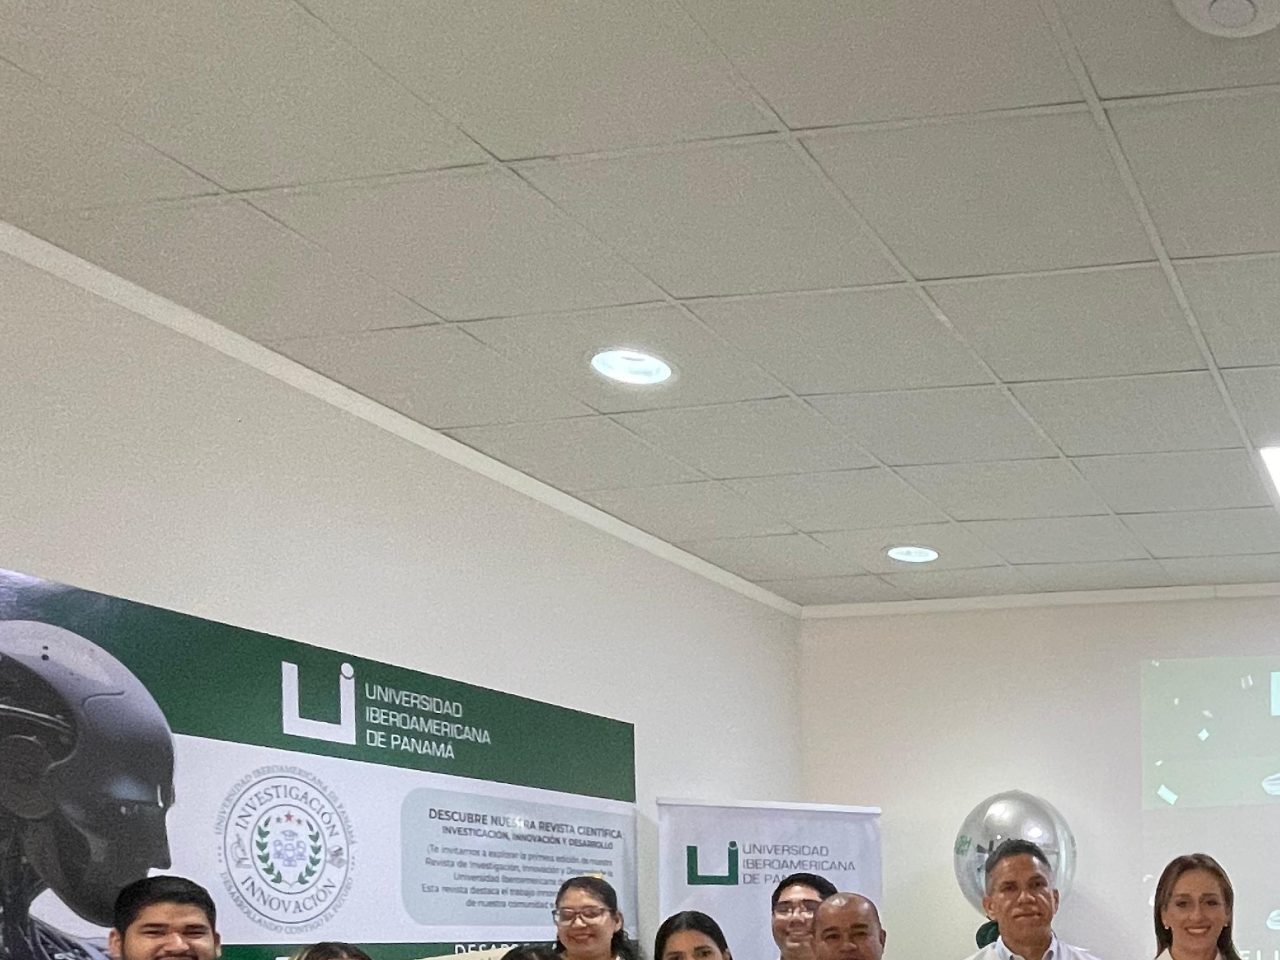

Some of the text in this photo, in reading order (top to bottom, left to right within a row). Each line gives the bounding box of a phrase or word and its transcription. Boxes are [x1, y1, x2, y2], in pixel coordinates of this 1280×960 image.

[365, 683, 463, 718] UNIVERSIDAD
[366, 707, 491, 744] IBEROAMERICANA
[366, 729, 455, 759] DE PANAMÁ
[236, 785, 340, 838] INVESTIGACIÓN
[428, 808, 488, 825] DESCUBRE
[538, 820, 575, 834] REVISTA
[568, 838, 613, 850] DESARROLLO
[742, 843, 829, 857] UNIVERSIDAD
[425, 857, 455, 868] Revista
[742, 858, 856, 871] IBEROAMERICANA
[421, 883, 440, 894] Esta
[743, 874, 761, 885] DE
[241, 876, 337, 914] INNOVACIÓN
